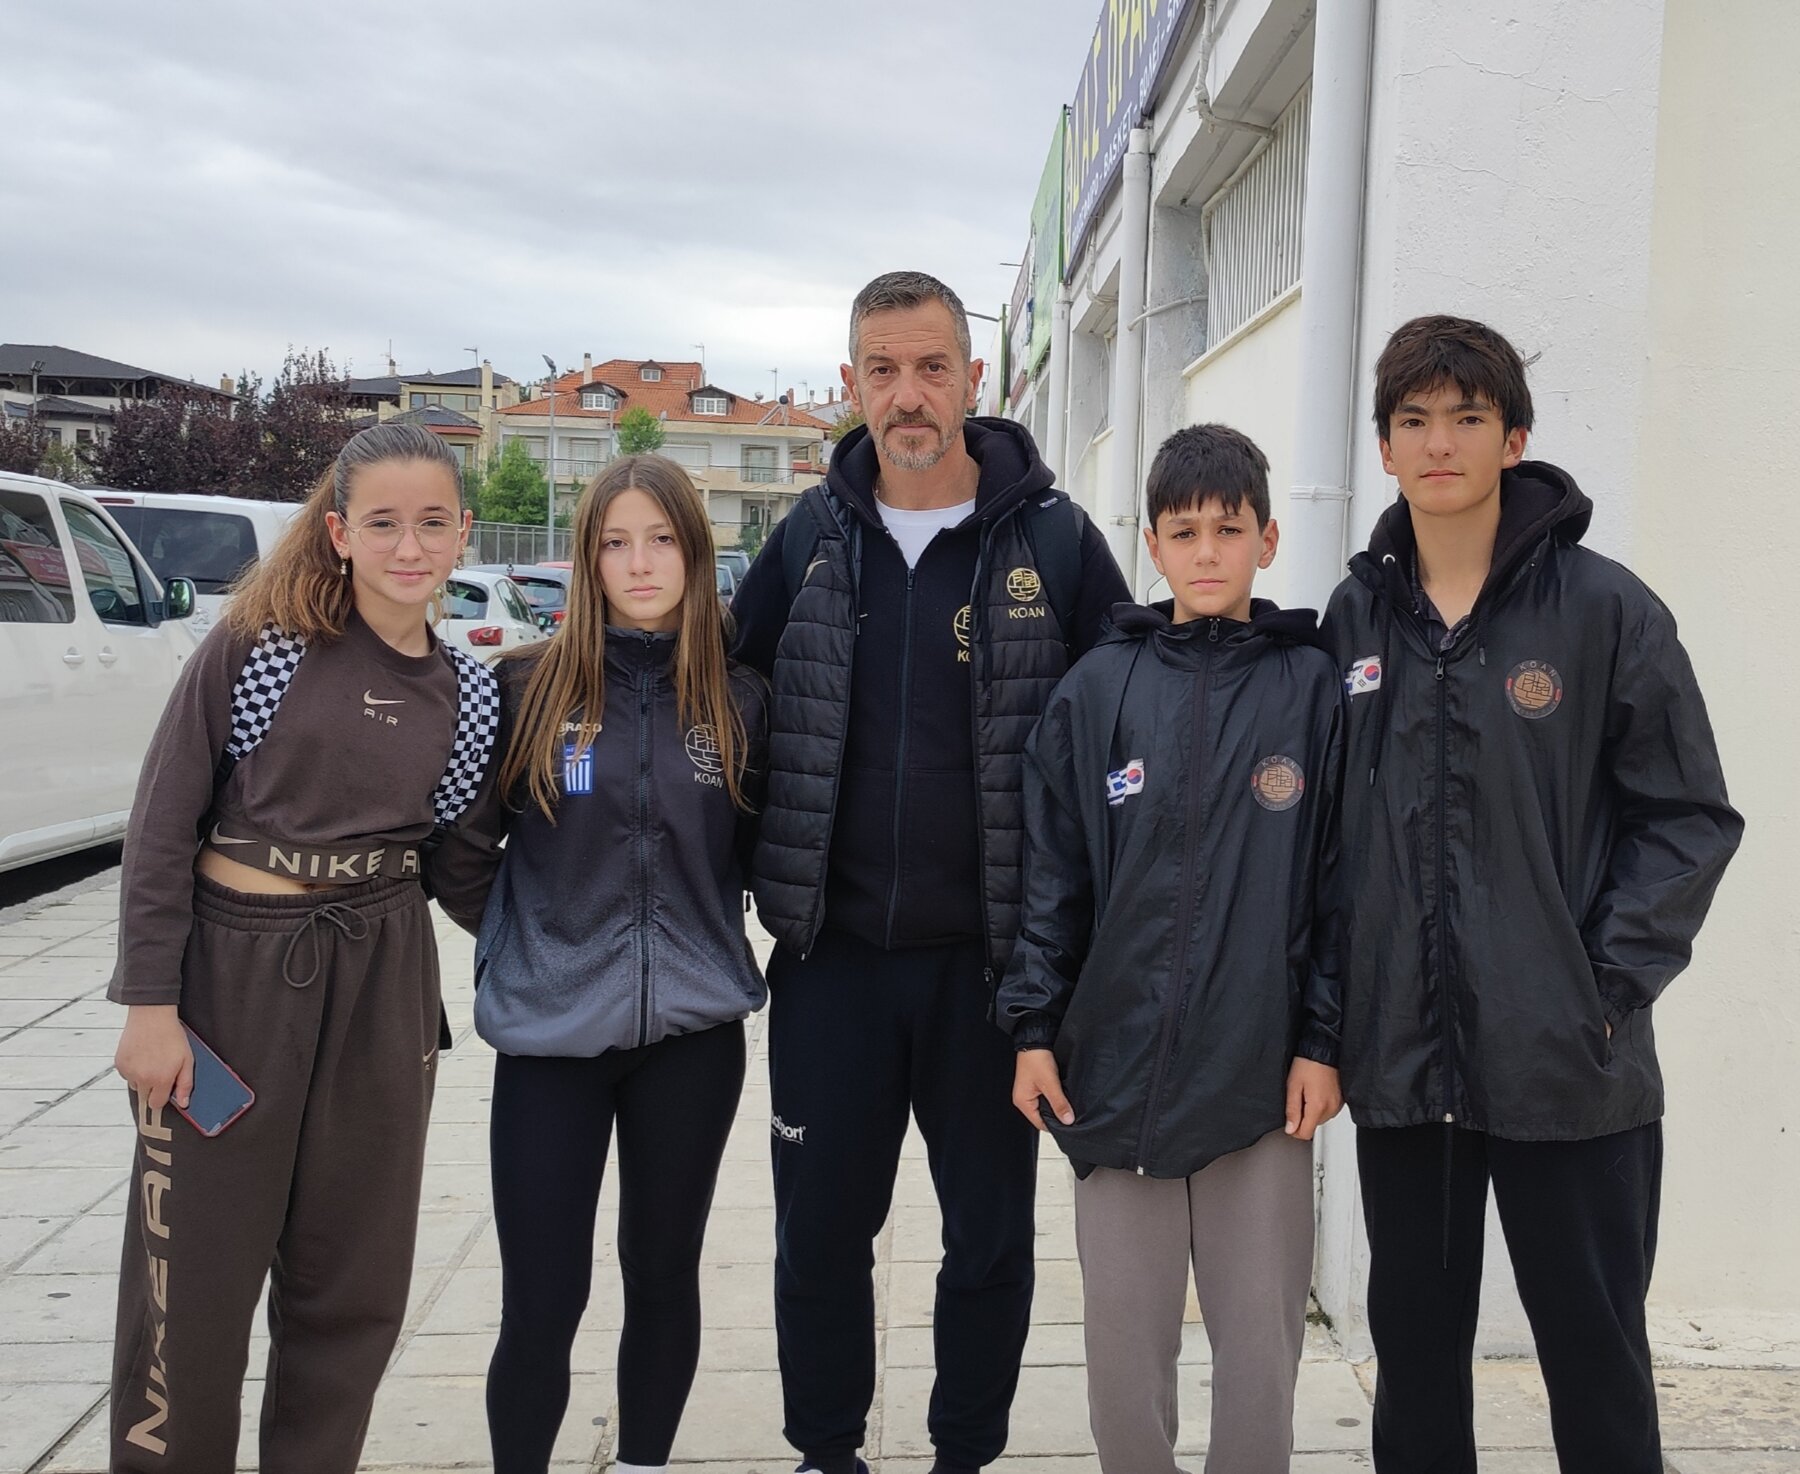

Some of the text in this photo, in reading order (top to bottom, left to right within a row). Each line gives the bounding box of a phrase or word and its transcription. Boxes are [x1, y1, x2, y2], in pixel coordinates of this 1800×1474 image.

[1103, 101, 1132, 178] BASKET
[1008, 606, 1045, 619] KOAN
[1519, 660, 1557, 677] KOAN
[363, 707, 399, 727] AIR
[1260, 756, 1297, 769] KOAN
[694, 771, 724, 789] KOAN
[268, 846, 386, 878] NIKE
